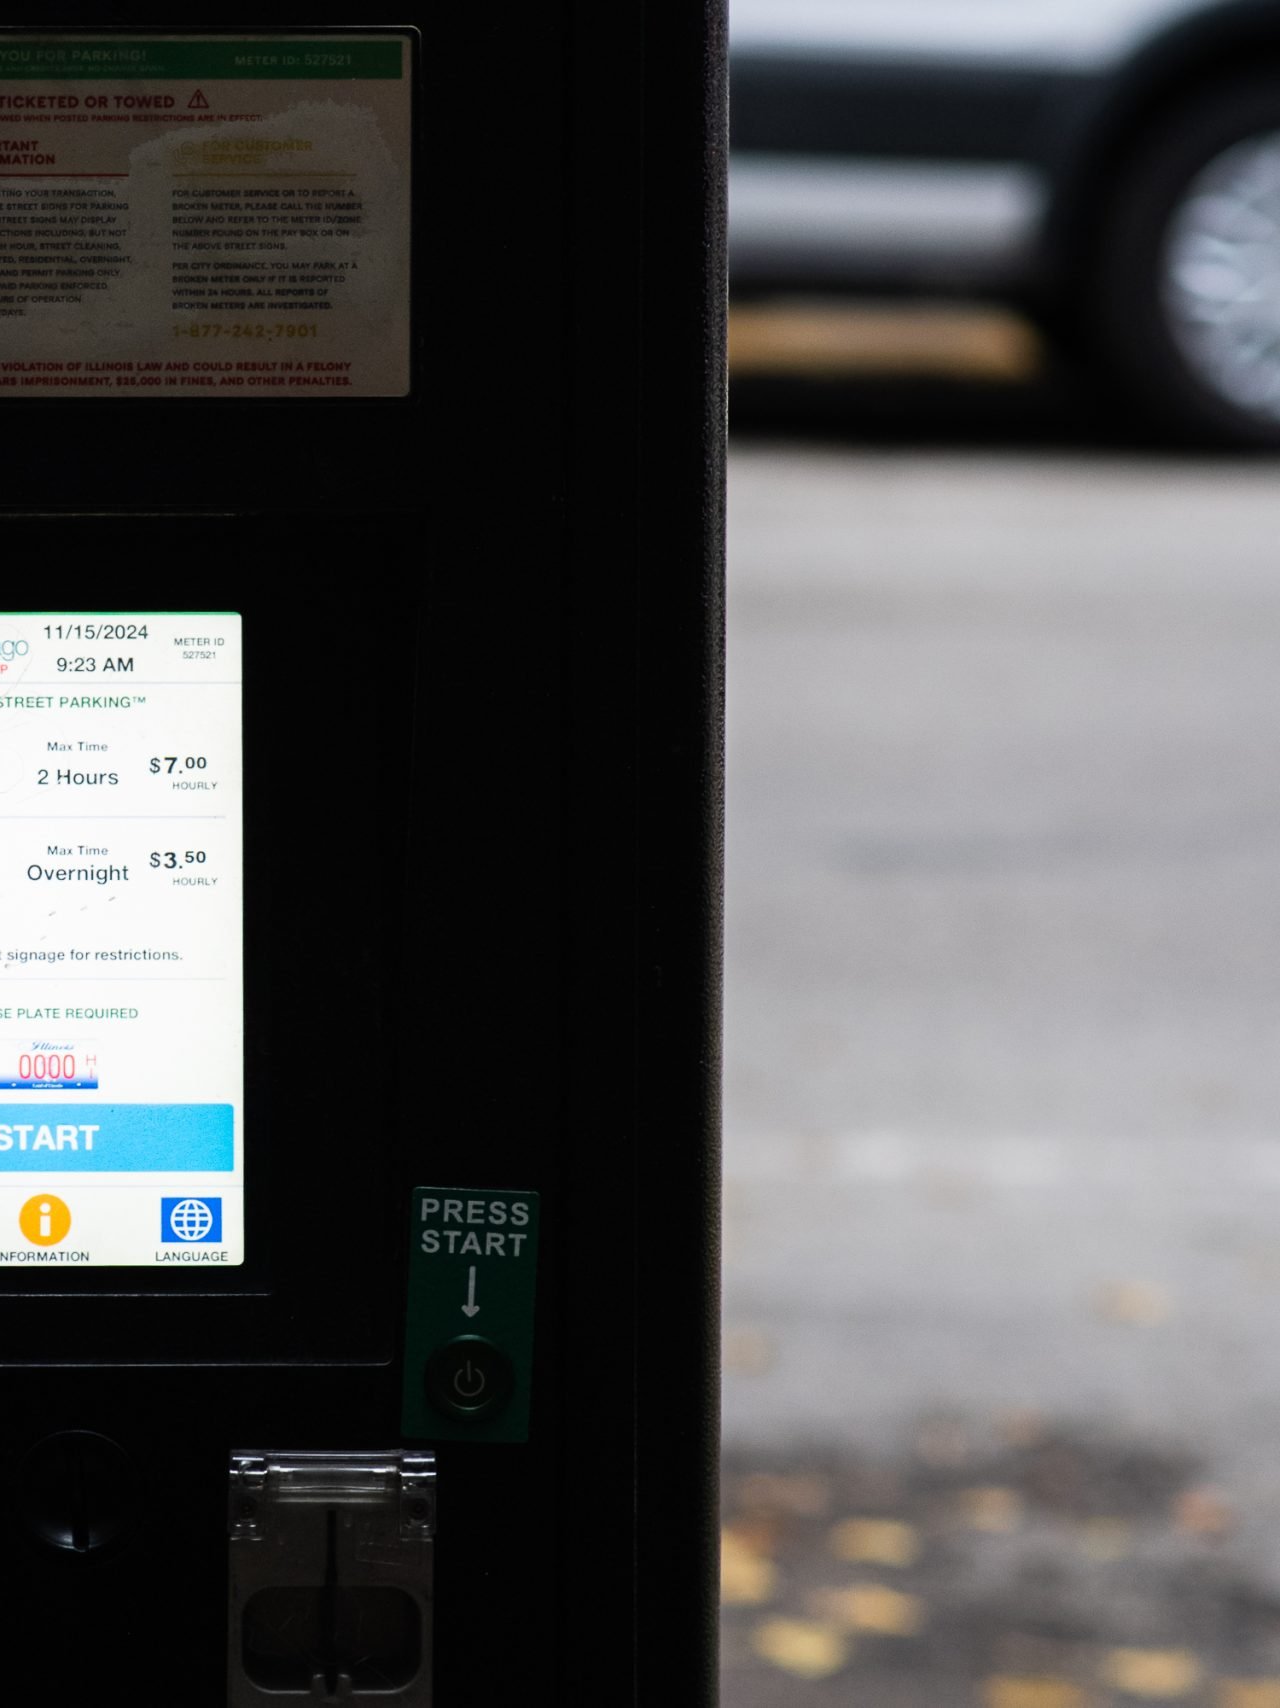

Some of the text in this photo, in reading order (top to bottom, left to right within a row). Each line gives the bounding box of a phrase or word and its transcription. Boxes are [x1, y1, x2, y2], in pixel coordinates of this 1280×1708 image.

[0, 50, 30, 62] YOU
[36, 50, 65, 62] FOR
[72, 50, 147, 62] PARKING!
[235, 53, 352, 65] METER ID: 527521
[85, 96, 111, 108] OR
[115, 96, 175, 108] TOWED
[1, 363, 64, 371] VIOLATION
[66, 363, 81, 371] OF
[85, 363, 133, 371] ILLINOIS
[137, 363, 162, 371] LAW
[165, 363, 190, 371] AND
[193, 363, 233, 371] COULD
[236, 363, 277, 371] RESULT
[281, 363, 293, 371] IN
[296, 363, 304, 371] A
[307, 363, 351, 371] FELONY
[20, 377, 112, 387] IMPRISONMENT,
[165, 377, 177, 386] IN
[180, 377, 216, 387] FINES,
[220, 377, 244, 386] AND
[247, 377, 285, 386] OTHER
[289, 377, 352, 386] PENALTIES.
[44, 624, 148, 640] 11/15/2024
[174, 638, 225, 646] METER ID
[182, 651, 216, 659] 527521
[56, 657, 134, 672] 9:23 AM
[47, 742, 108, 752] Max Time
[37, 769, 119, 785] 2 Hours
[172, 782, 218, 790] HOURLY
[47, 846, 108, 855] Max Time
[27, 865, 129, 885] Overnight
[172, 877, 218, 886] HOURLY
[7, 949, 65, 964] signage
[70, 948, 89, 961] for
[95, 948, 183, 961] restrictions.
[17, 1008, 61, 1019] PLATE
[65, 1008, 139, 1019] REQUIRED
[19, 1054, 75, 1079] 0000
[420, 1198, 529, 1226] PRESS
[420, 1229, 527, 1257] START
[155, 1252, 228, 1262] LANGUAGE
